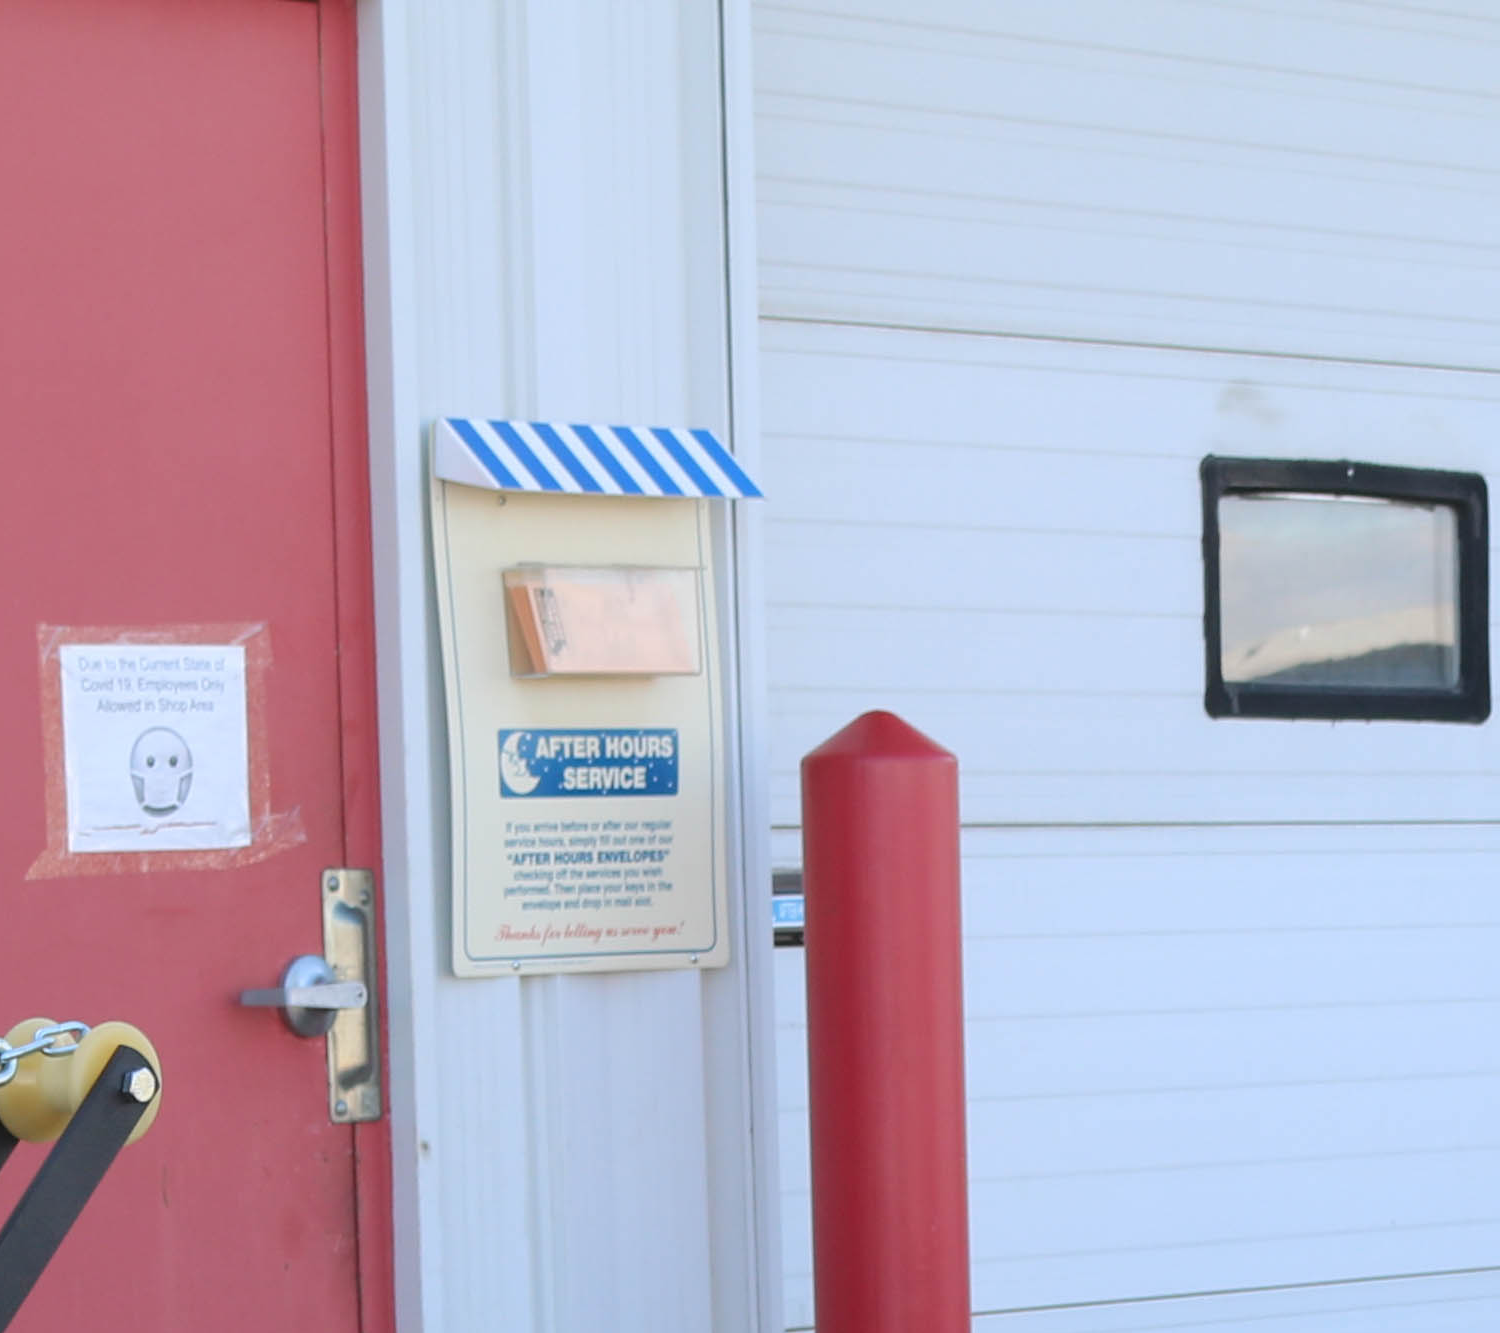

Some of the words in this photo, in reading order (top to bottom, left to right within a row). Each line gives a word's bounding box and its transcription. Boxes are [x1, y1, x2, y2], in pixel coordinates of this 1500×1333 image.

[137, 677, 198, 694] Employees
[201, 678, 225, 694] Only
[96, 699, 142, 712] Allowed
[158, 699, 188, 714] Shop
[189, 699, 214, 712] Area
[535, 735, 600, 759] AFTER
[605, 735, 673, 758] HOURS
[563, 766, 647, 790] SERVICE
[561, 822, 588, 832] before
[603, 821, 621, 831] after
[504, 838, 536, 848] service
[569, 836, 597, 848] simply
[554, 852, 593, 864] HOURS
[495, 924, 541, 941] Thanks
[541, 922, 561, 947] for
